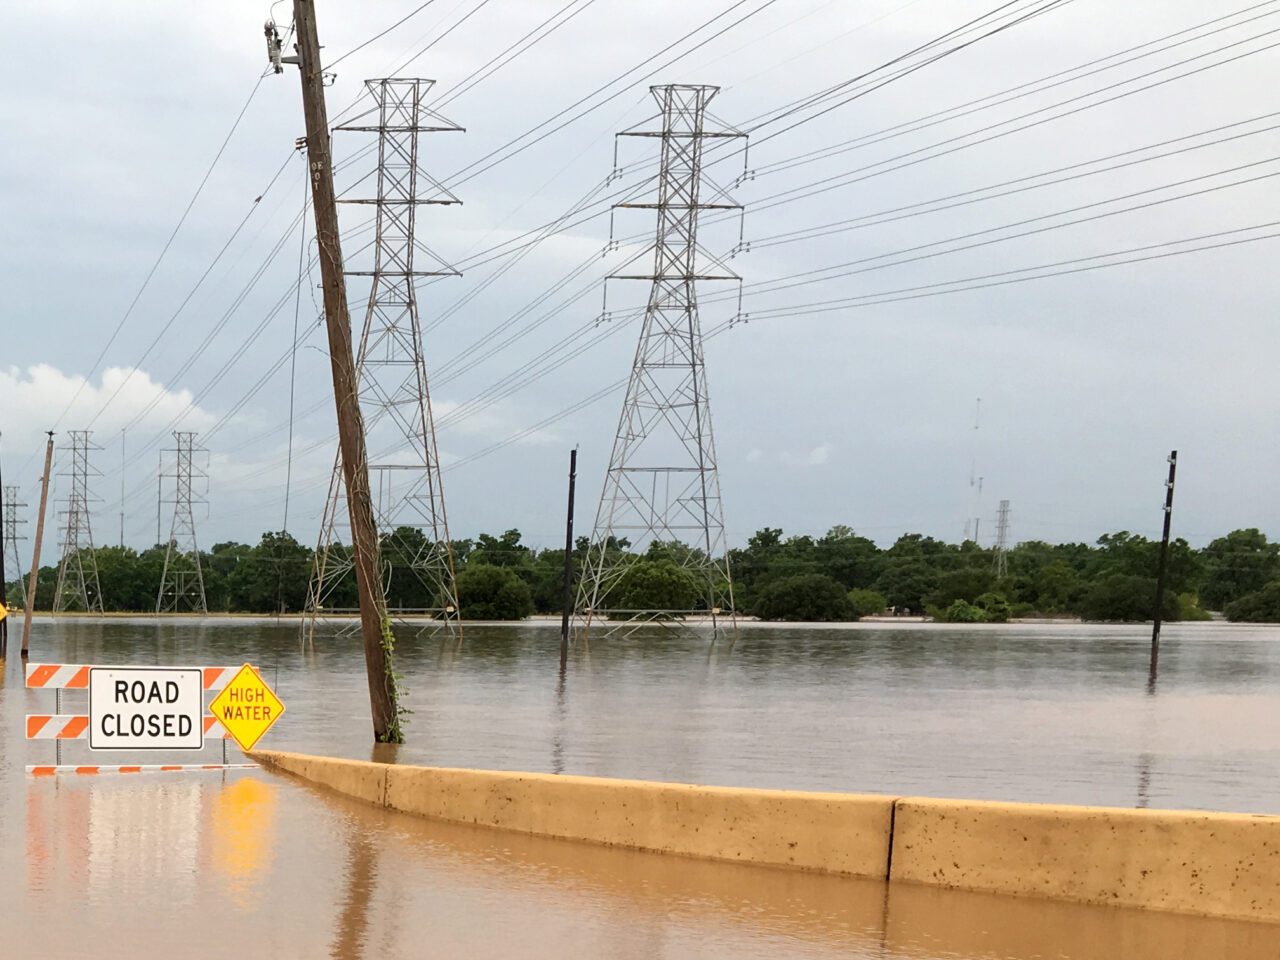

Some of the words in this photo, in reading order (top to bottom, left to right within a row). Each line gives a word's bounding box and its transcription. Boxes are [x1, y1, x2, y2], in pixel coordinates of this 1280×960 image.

[114, 680, 179, 703] ROAD
[229, 687, 265, 702] HIGH
[222, 705, 271, 721] WATER
[101, 713, 192, 737] CLOSED
